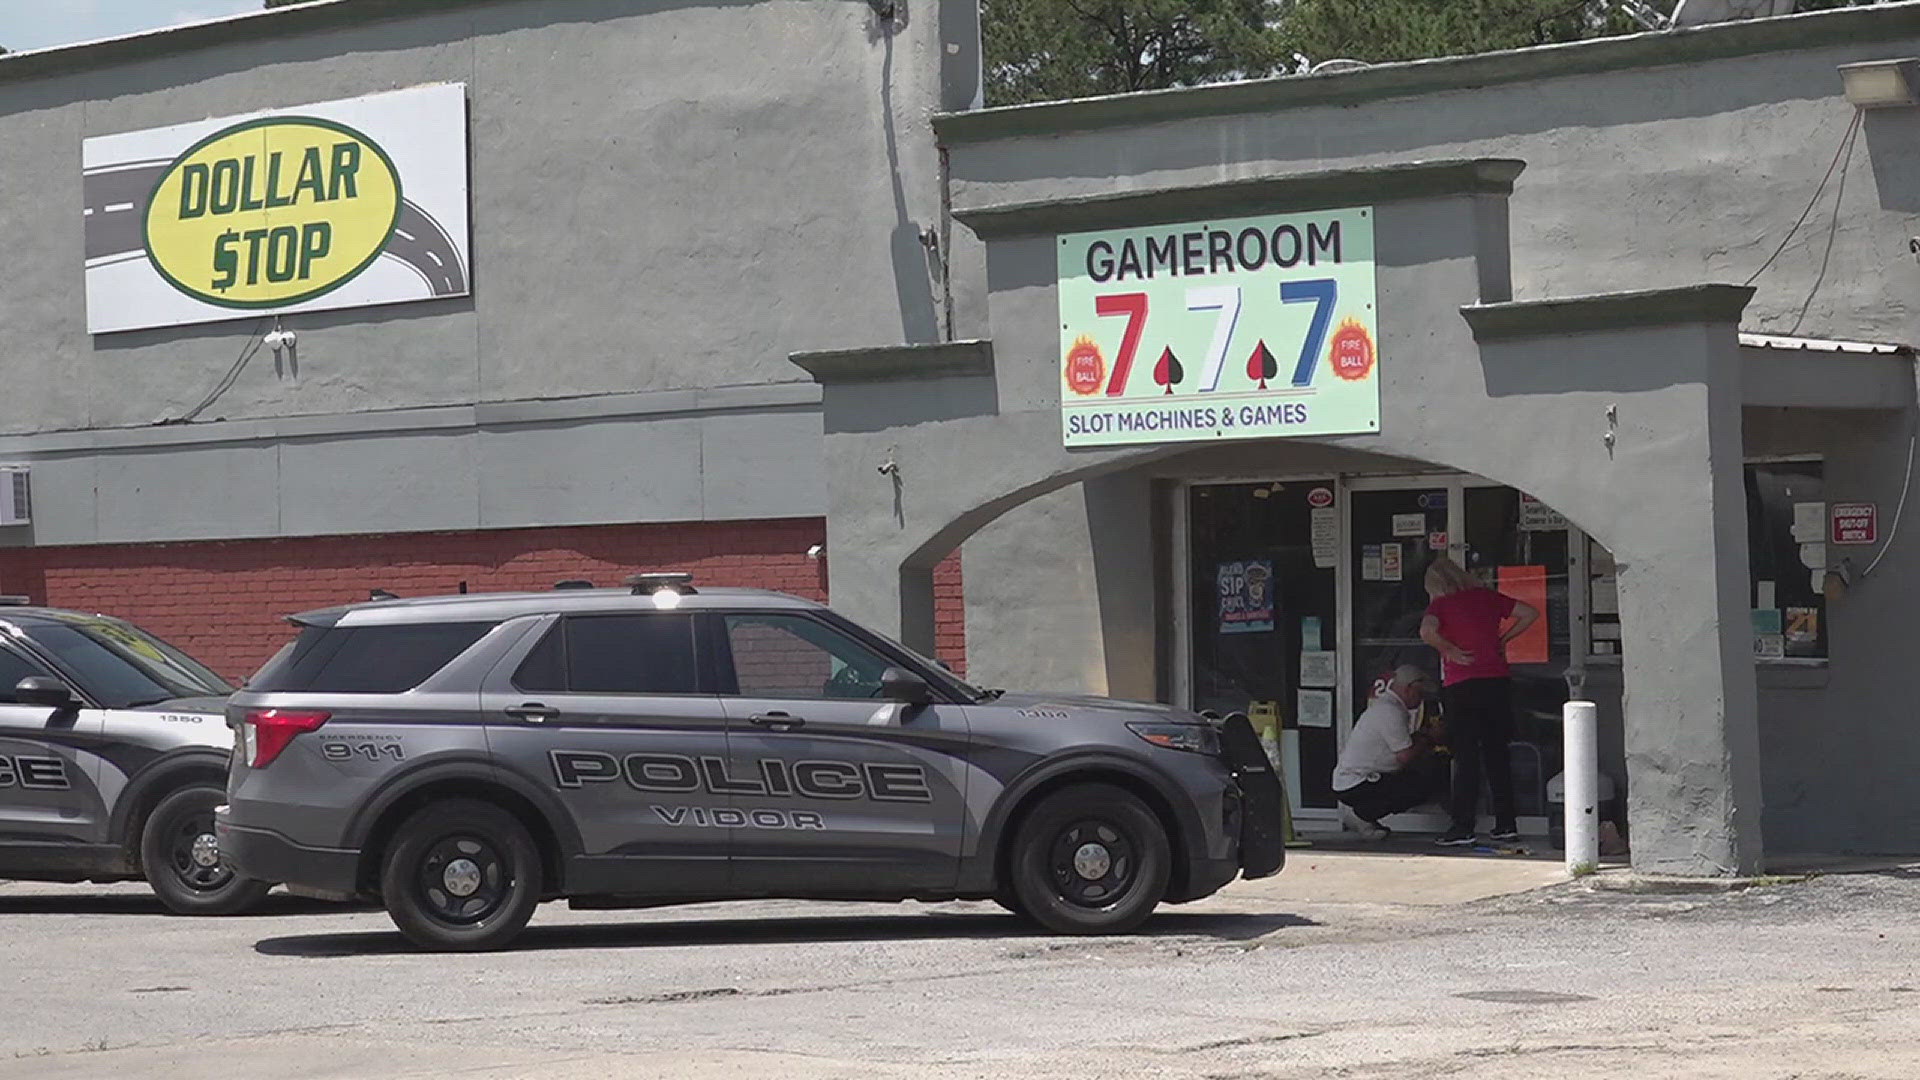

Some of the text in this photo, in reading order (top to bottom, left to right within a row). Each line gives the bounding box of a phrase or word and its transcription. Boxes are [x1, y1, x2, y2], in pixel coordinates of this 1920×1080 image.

[178, 141, 361, 221] DOLLAR
[211, 220, 332, 294] $TOP
[1086, 220, 1342, 283] GAMEROOM
[1095, 278, 1338, 398] 7 7 7
[1341, 339, 1362, 351] FIRE
[1076, 355, 1095, 366] FIRE
[1339, 355, 1364, 369] BALL
[1075, 372, 1097, 383] BALL
[1069, 403, 1307, 435] SLOT MACHINES & GAMES
[1221, 576, 1244, 596] SIP
[159, 714, 203, 724] 1350
[321, 741, 406, 762] 911
[548, 748, 932, 804] POLICE
[649, 804, 827, 831] VIDOR
